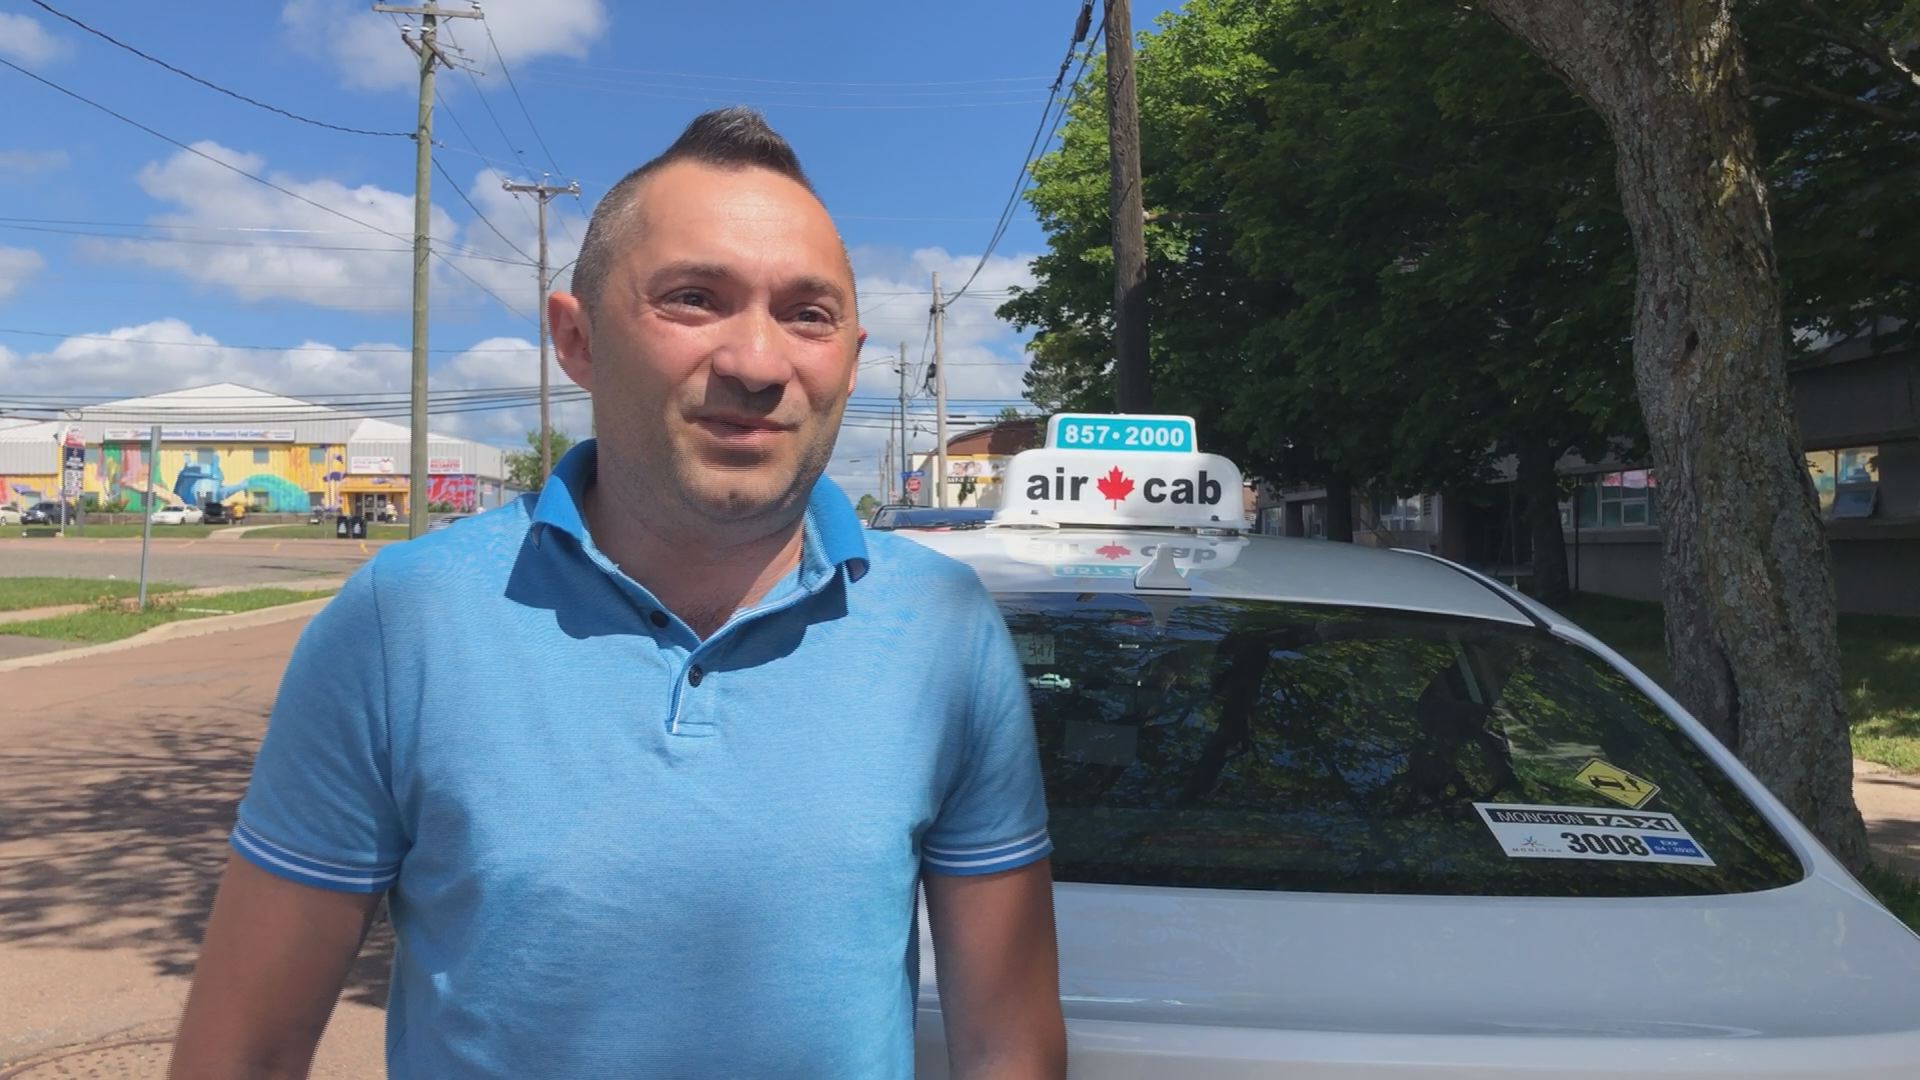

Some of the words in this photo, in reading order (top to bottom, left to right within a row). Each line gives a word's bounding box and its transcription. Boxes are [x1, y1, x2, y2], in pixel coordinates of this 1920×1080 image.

[1026, 467, 1089, 501] air
[1143, 471, 1222, 505] cab
[1496, 811, 1584, 826] MONCTON
[1584, 814, 1675, 831] TAXI
[1560, 832, 1650, 857] 3008
